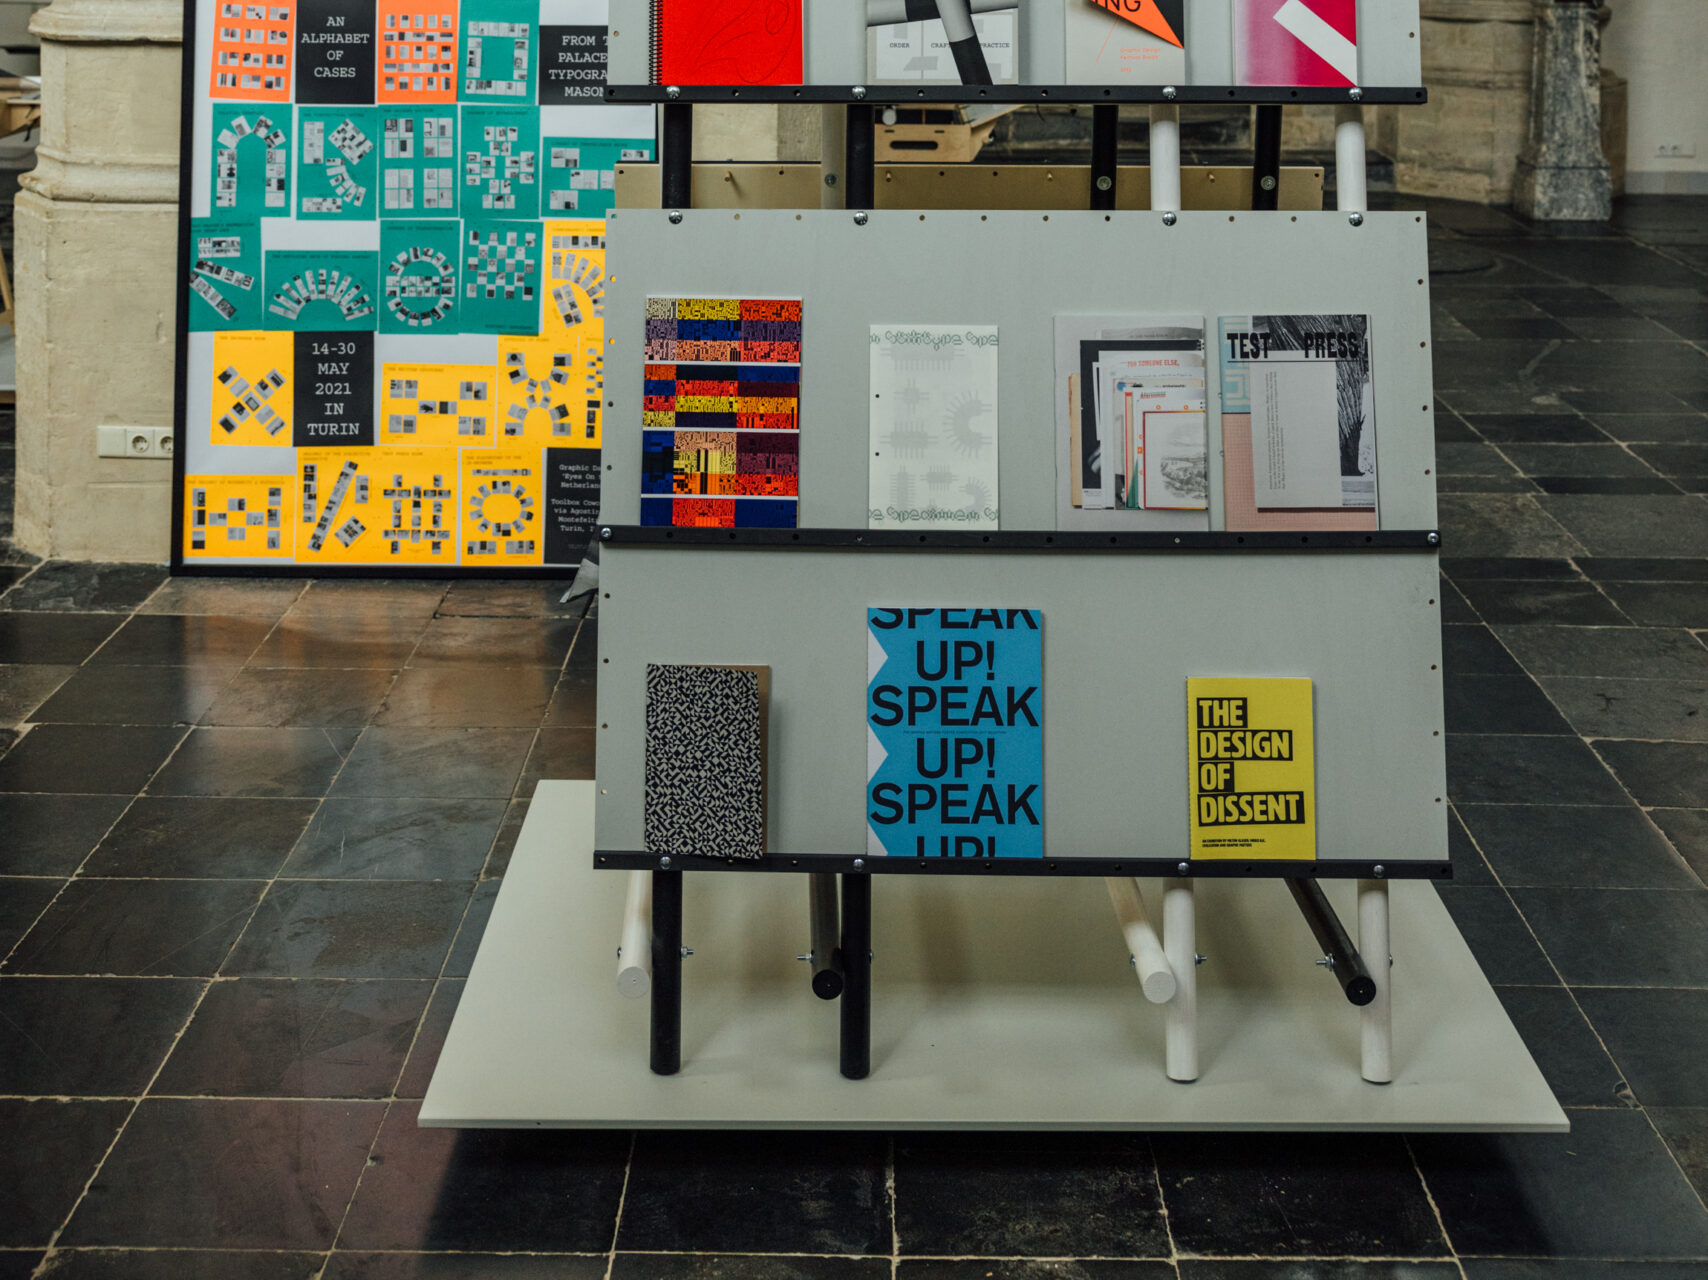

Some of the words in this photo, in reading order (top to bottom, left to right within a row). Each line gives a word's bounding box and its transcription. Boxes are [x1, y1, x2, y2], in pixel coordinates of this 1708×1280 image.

[326, 16, 345, 27] AN
[301, 33, 370, 44] ALPHABET
[562, 35, 596, 46] FROM
[327, 50, 344, 61] OF
[558, 52, 608, 63] PALACE
[314, 67, 356, 78] CASES
[312, 343, 356, 355] 14-30
[1227, 332, 1271, 359] TEST
[1304, 331, 1359, 359] PRESS
[317, 363, 350, 375] MAY
[315, 383, 352, 395] 2021
[324, 403, 345, 415] IN
[307, 423, 360, 436] TURIN
[916, 640, 995, 681] UP!
[870, 684, 1039, 727] SPEAK
[1199, 699, 1244, 727] THE
[1200, 731, 1290, 759] DESIGN
[916, 737, 995, 778] UP!
[1200, 763, 1231, 791] OF
[870, 782, 1040, 825] SPEAK
[1200, 793, 1300, 824] DISSENT
